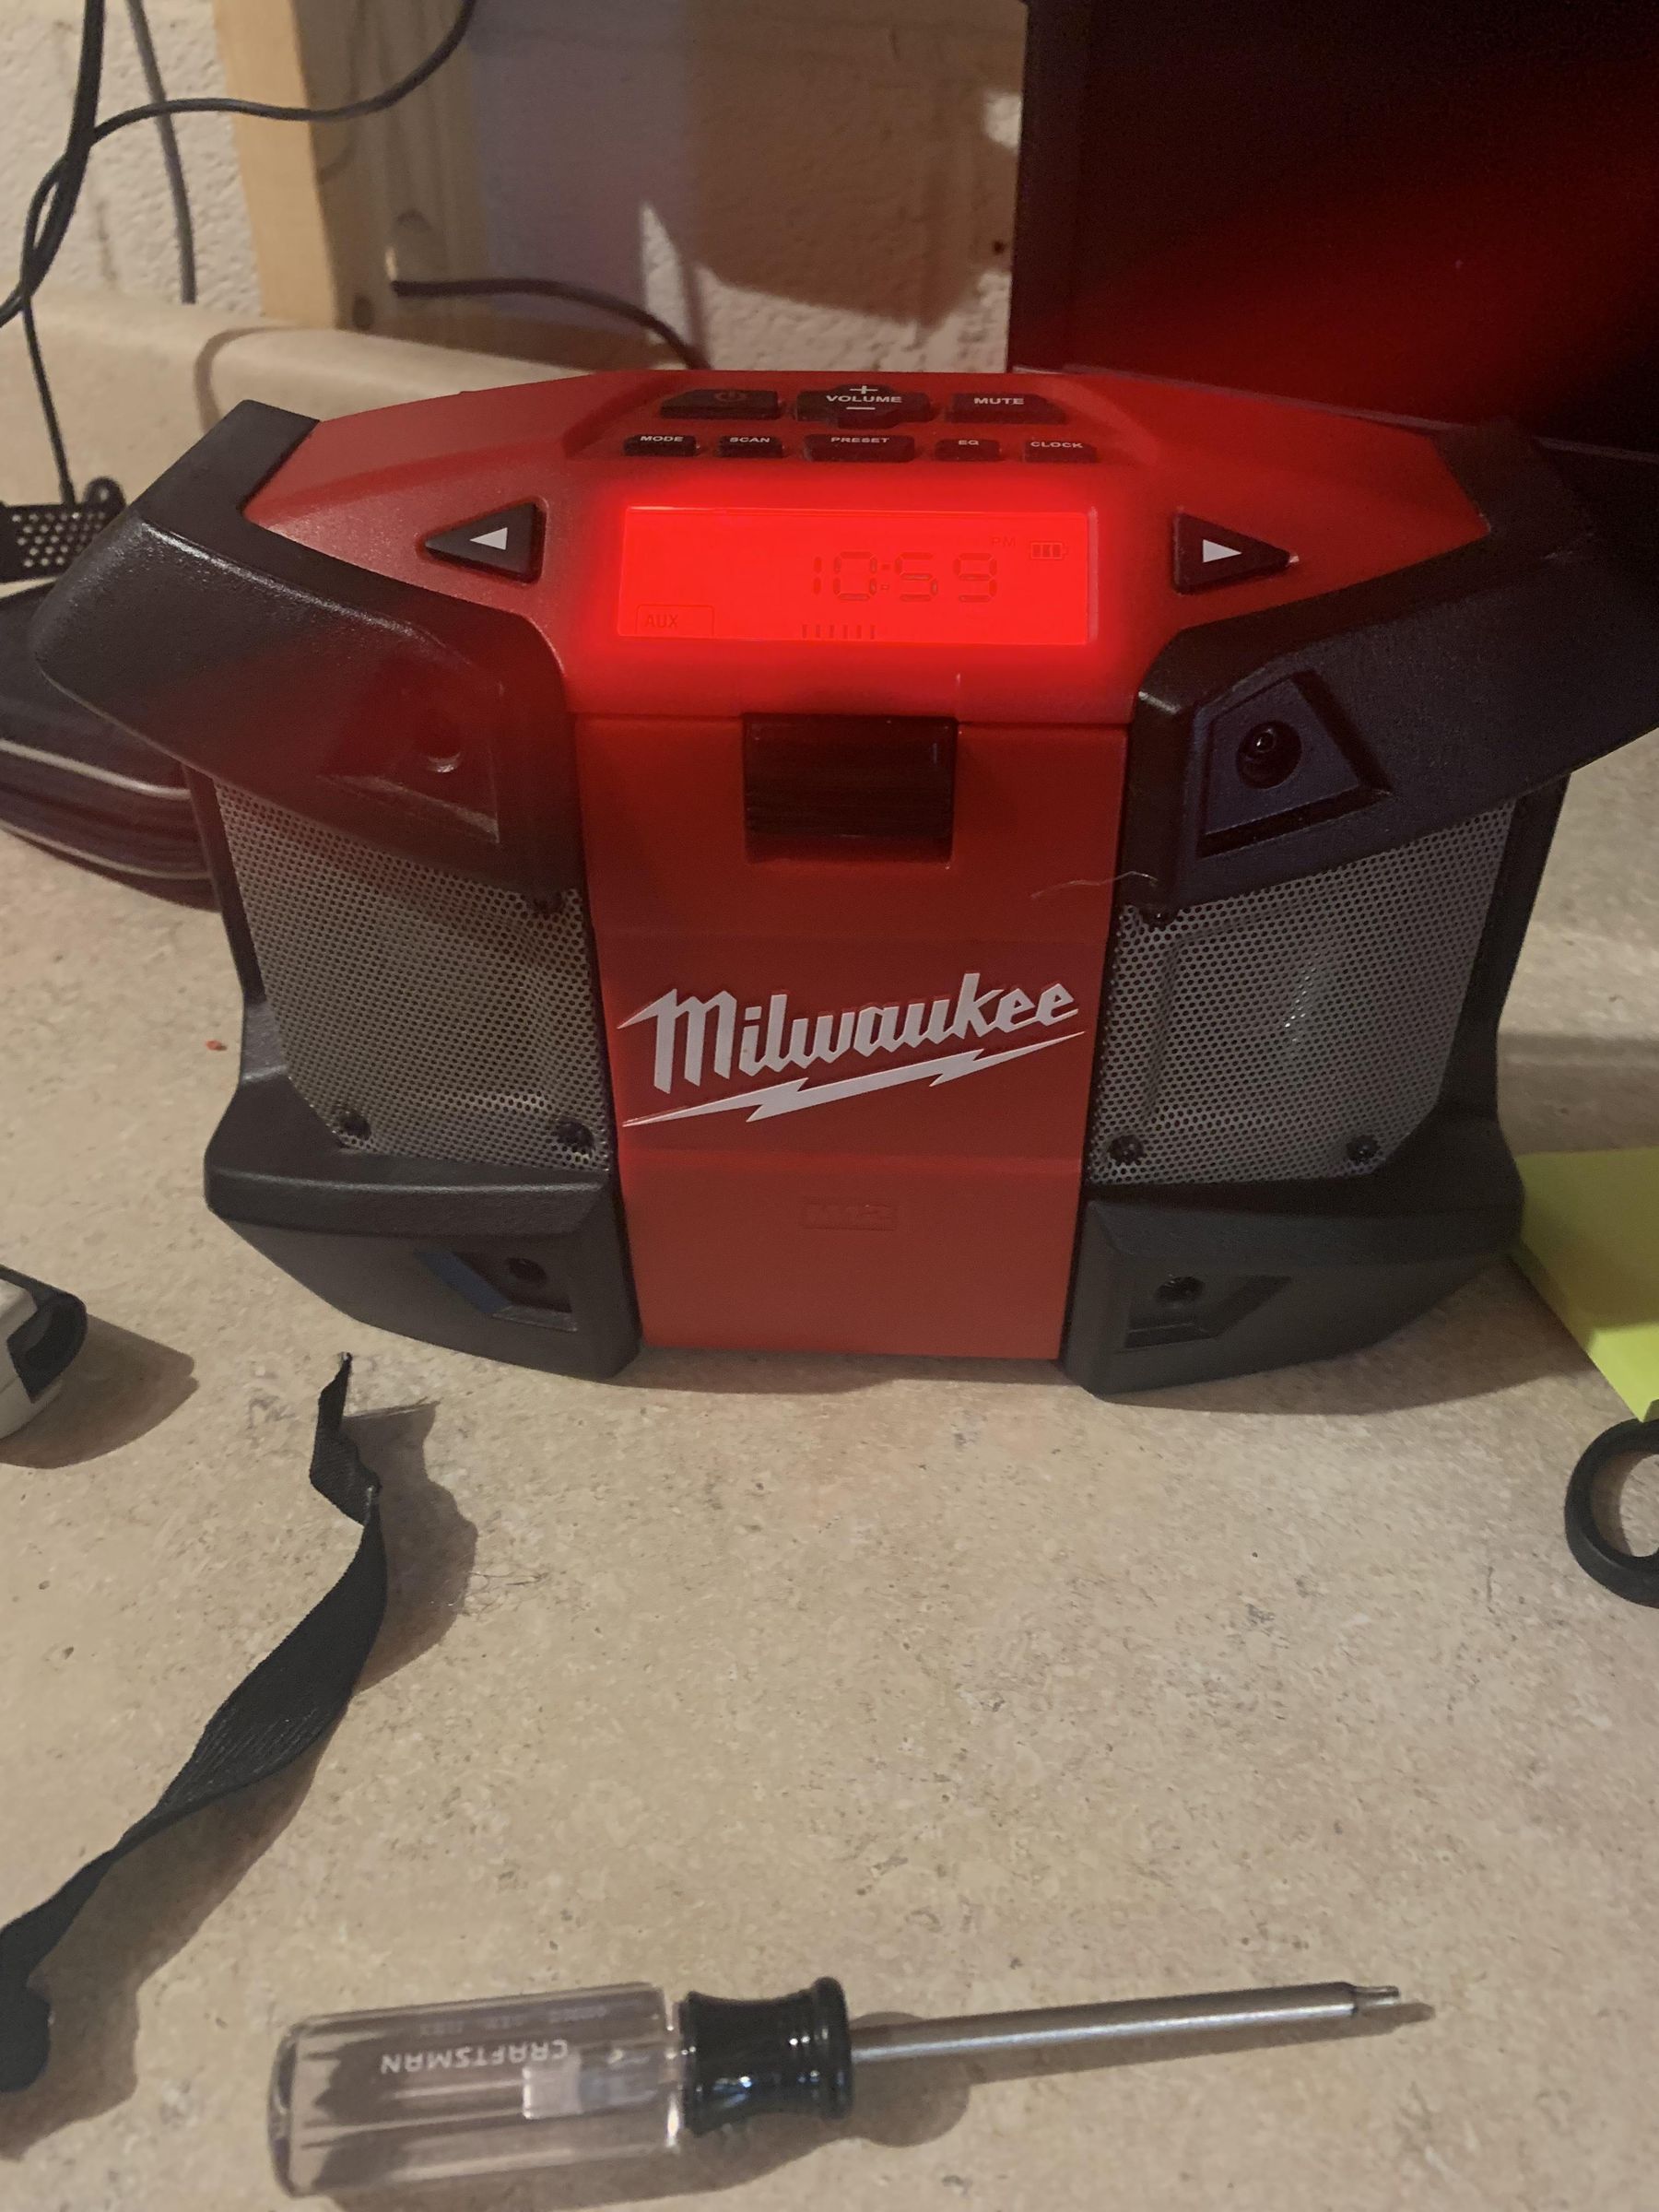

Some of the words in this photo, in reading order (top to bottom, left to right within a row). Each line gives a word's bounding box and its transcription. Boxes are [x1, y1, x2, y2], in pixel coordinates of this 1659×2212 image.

[826, 394, 902, 405] VOLUME
[972, 396, 1025, 406] MUTE
[640, 434, 684, 442] MODE
[729, 436, 771, 444] SCAN
[830, 436, 890, 444] PRESET
[958, 439, 980, 447] EQ
[1030, 441, 1084, 450] CLOCK
[991, 535, 1016, 548] PM
[812, 550, 998, 603] 10:59
[644, 614, 679, 629] AUX
[617, 972, 1079, 1094] Milwaukee
[379, 2039, 569, 2075] CRAFTSMAN
